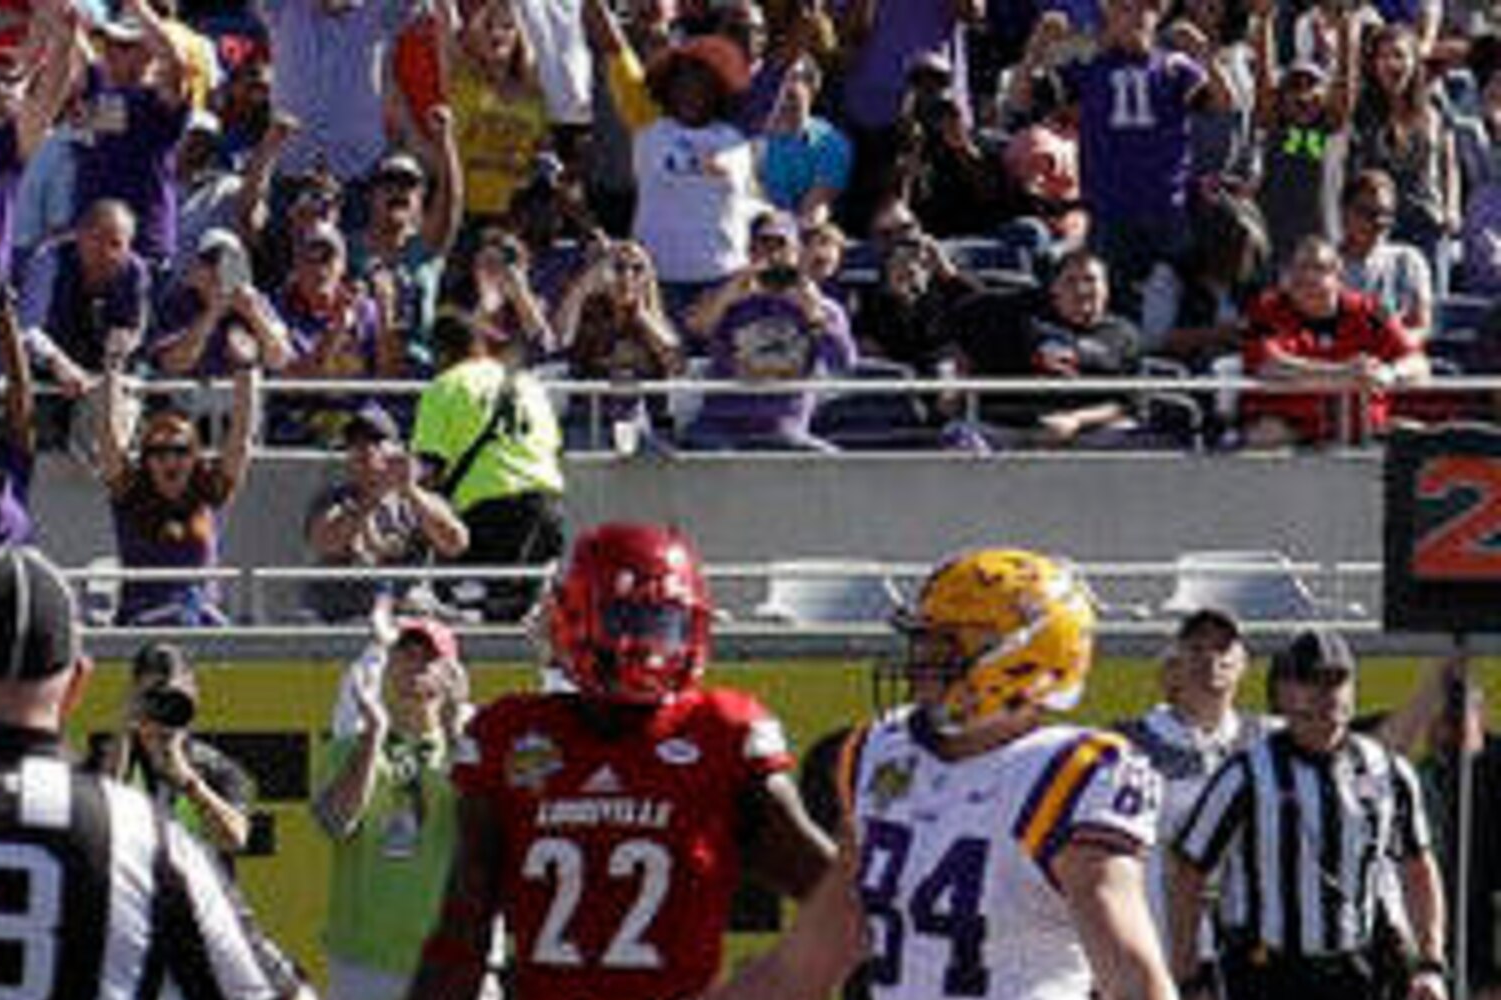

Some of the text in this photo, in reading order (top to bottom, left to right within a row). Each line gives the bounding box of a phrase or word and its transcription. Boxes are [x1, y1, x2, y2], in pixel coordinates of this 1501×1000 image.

[1108, 67, 1157, 129] 11
[520, 836, 673, 967] 22
[854, 815, 991, 998] 84
